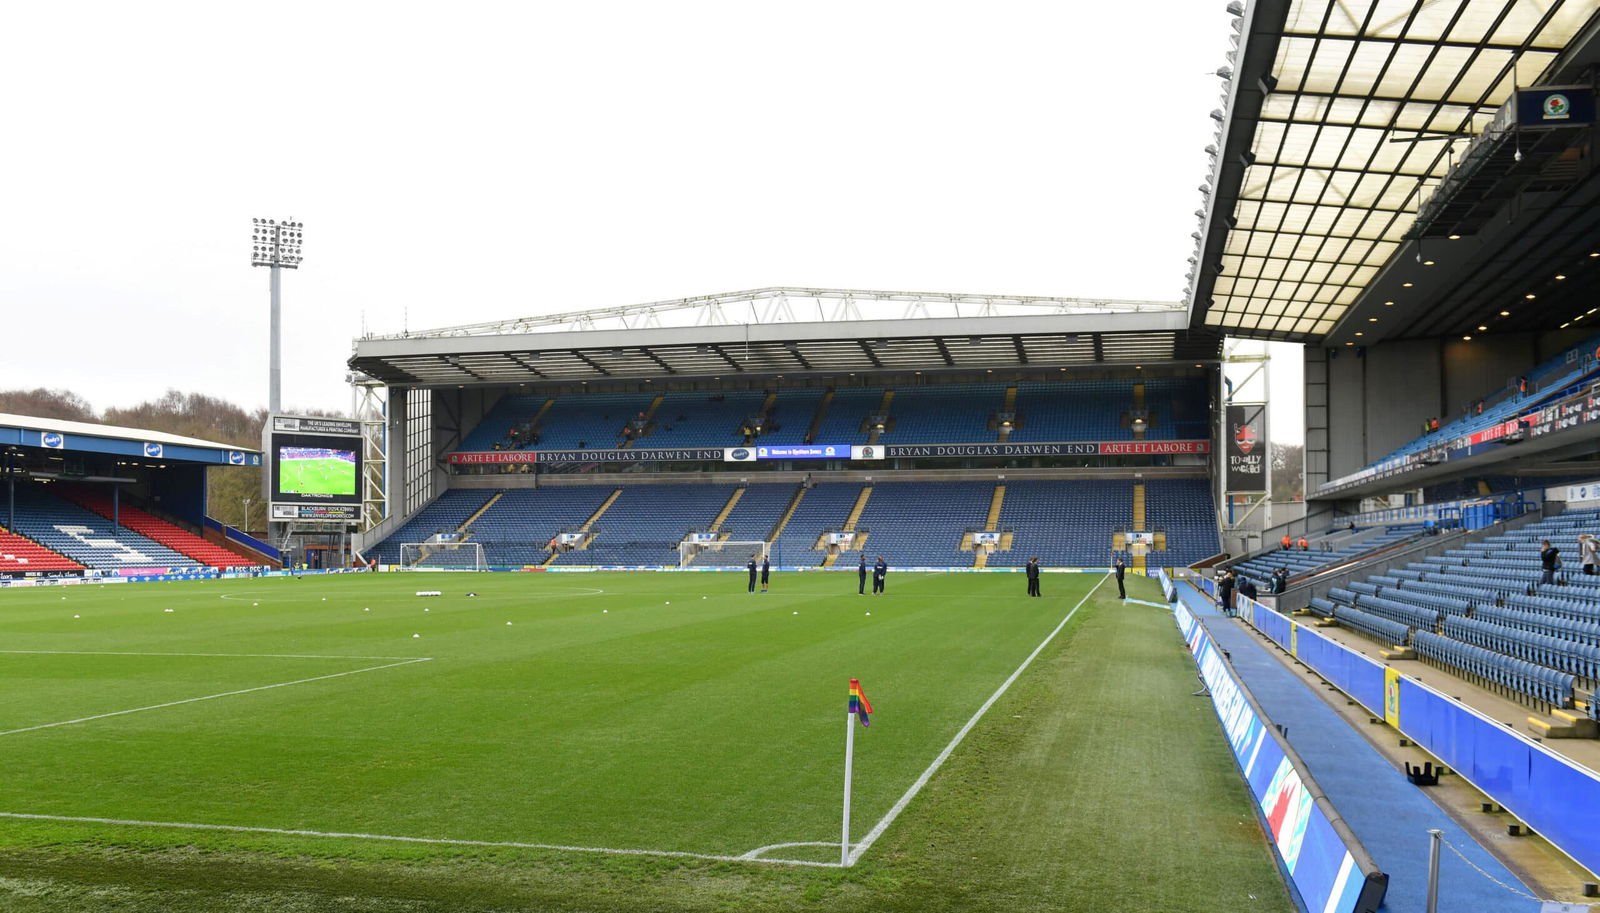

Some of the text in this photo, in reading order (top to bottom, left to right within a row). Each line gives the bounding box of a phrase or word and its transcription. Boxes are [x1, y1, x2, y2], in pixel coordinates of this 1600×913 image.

[890, 444, 1095, 456] BRYAN DOUGLAS DARWEN END
[1104, 443, 1193, 453] ARTE ET LABORE
[461, 453, 533, 462] ARTE ET LABORE
[539, 450, 721, 462] BRYAN DOUGLAS DARWEN END
